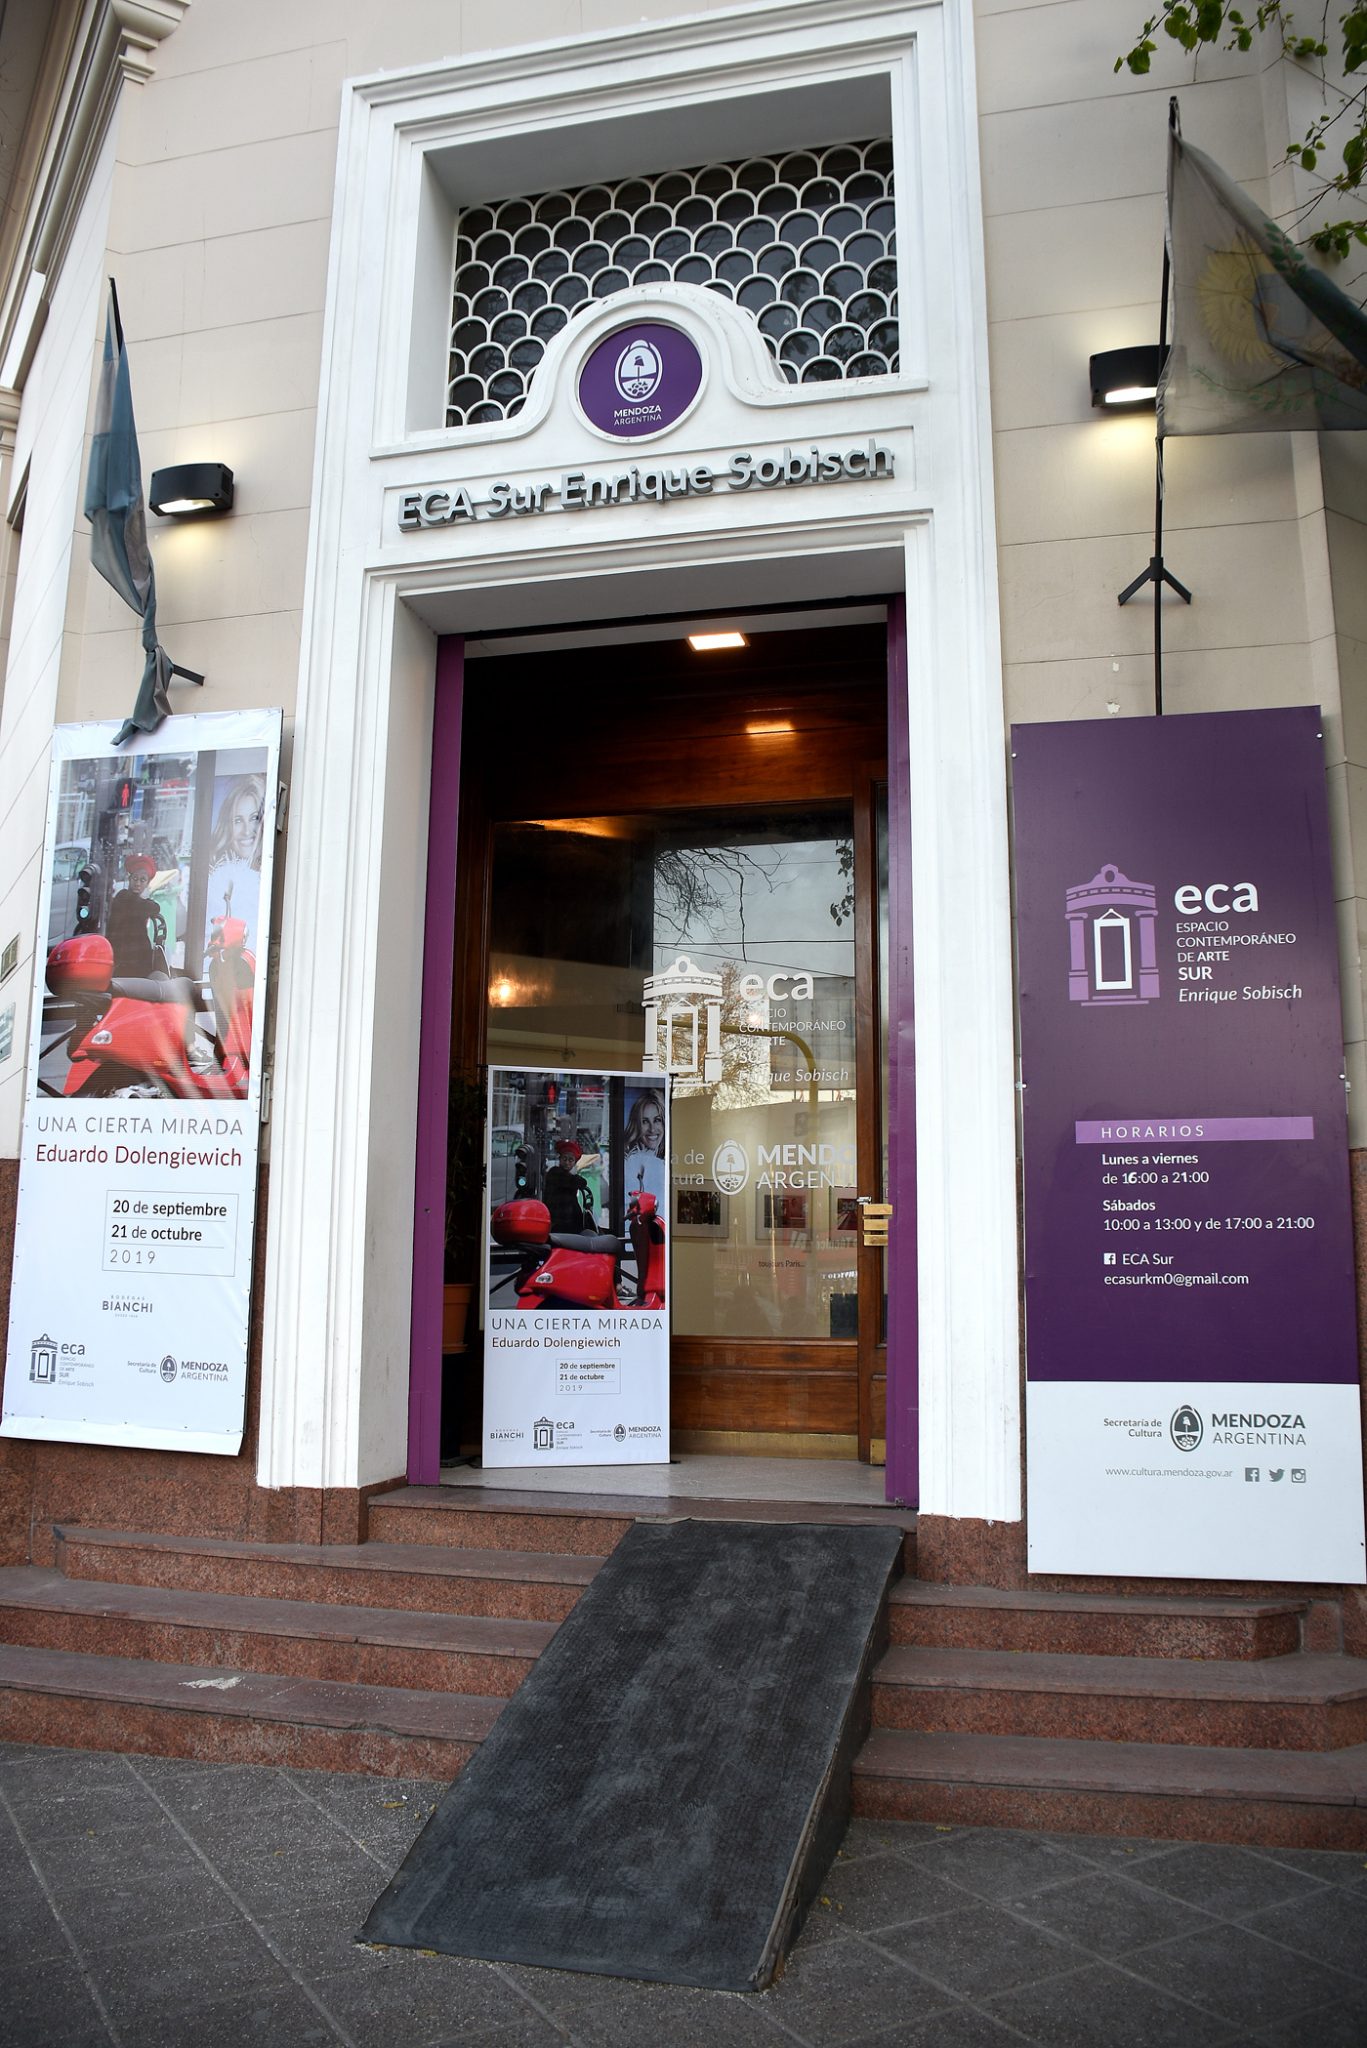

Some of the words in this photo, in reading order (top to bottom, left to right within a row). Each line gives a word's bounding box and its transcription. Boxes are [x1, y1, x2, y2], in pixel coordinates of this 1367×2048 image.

[614, 404, 662, 419] MENDOZA
[614, 413, 662, 427] ARGENTINA
[399, 487, 475, 530] ECA
[486, 481, 553, 517] Sur
[560, 465, 713, 510] Enrique
[729, 438, 895, 490] Sobisch
[1174, 882, 1259, 915] eca
[1176, 921, 1229, 933] ESPACIO
[1176, 932, 1297, 948] CONTEMPORÁNEO
[1177, 952, 1195, 963] DE
[1197, 950, 1230, 962] ARTE
[1178, 966, 1213, 981] SUR
[739, 972, 814, 1001] eca
[1178, 987, 1238, 1004] Enrique
[1242, 984, 1303, 1001] Sobisch
[795, 1068, 849, 1082] Sobisch
[37, 1117, 77, 1133] UNA
[85, 1117, 153, 1134] CIERTA
[161, 1118, 243, 1135] MIRADA
[1101, 1125, 1205, 1139] HORARIOS
[36, 1144, 108, 1164] Eduardo
[115, 1146, 242, 1168] Dolengiewich
[684, 1149, 705, 1165] de
[1102, 1153, 1139, 1165] Lunes
[1141, 1156, 1149, 1165] a
[1152, 1152, 1199, 1165] viernes
[1102, 1173, 1118, 1185] de
[1122, 1172, 1158, 1184] 16:00
[1161, 1175, 1169, 1184] a
[1172, 1171, 1210, 1184] 21:00
[113, 1200, 130, 1214] 20
[133, 1201, 149, 1214] de
[152, 1201, 227, 1218] septiembre
[1103, 1199, 1156, 1211] Sábados
[1103, 1218, 1140, 1231] 10:00
[1143, 1221, 1151, 1230] a
[1154, 1218, 1191, 1231] 13:00
[1194, 1221, 1202, 1233] y
[1205, 1218, 1221, 1230] de
[1225, 1217, 1262, 1230] 17:00
[1265, 1220, 1273, 1229] a
[1276, 1217, 1315, 1229] 21:00
[111, 1225, 127, 1238] 21
[132, 1226, 147, 1239] de
[151, 1227, 202, 1242] octubre
[109, 1249, 156, 1264] 2019
[1122, 1253, 1150, 1265] ECA
[1153, 1253, 1174, 1265] Sur
[1104, 1272, 1249, 1287] ecasurkm0@gmail.com
[102, 1300, 153, 1313] BIANCHI
[492, 1318, 527, 1330] UNA
[534, 1318, 592, 1330] CIERTA
[598, 1318, 663, 1330] MIRADA
[61, 1343, 86, 1356] eca
[492, 1337, 540, 1348] Eduardo
[544, 1337, 621, 1350] Dolengiewich
[181, 1361, 229, 1372] MENDOZA
[559, 1362, 569, 1370] 20
[569, 1362, 578, 1370] de
[579, 1362, 616, 1371] septiembre
[180, 1371, 229, 1382] ARGENTINA
[559, 1373, 569, 1381] 21
[569, 1373, 578, 1381] de
[579, 1373, 605, 1381] octubre
[559, 1384, 583, 1392] 2019
[556, 1421, 575, 1430] eca
[1103, 1417, 1149, 1428] Secretaría
[1150, 1418, 1162, 1428] de
[1212, 1413, 1306, 1429] MENDOZA
[490, 1432, 524, 1440] BIANCHI
[1128, 1428, 1162, 1438] Cultura
[1212, 1431, 1307, 1446] ARGENTINA
[1105, 1466, 1233, 1479] www.cultura.mendoza.gov.ar
